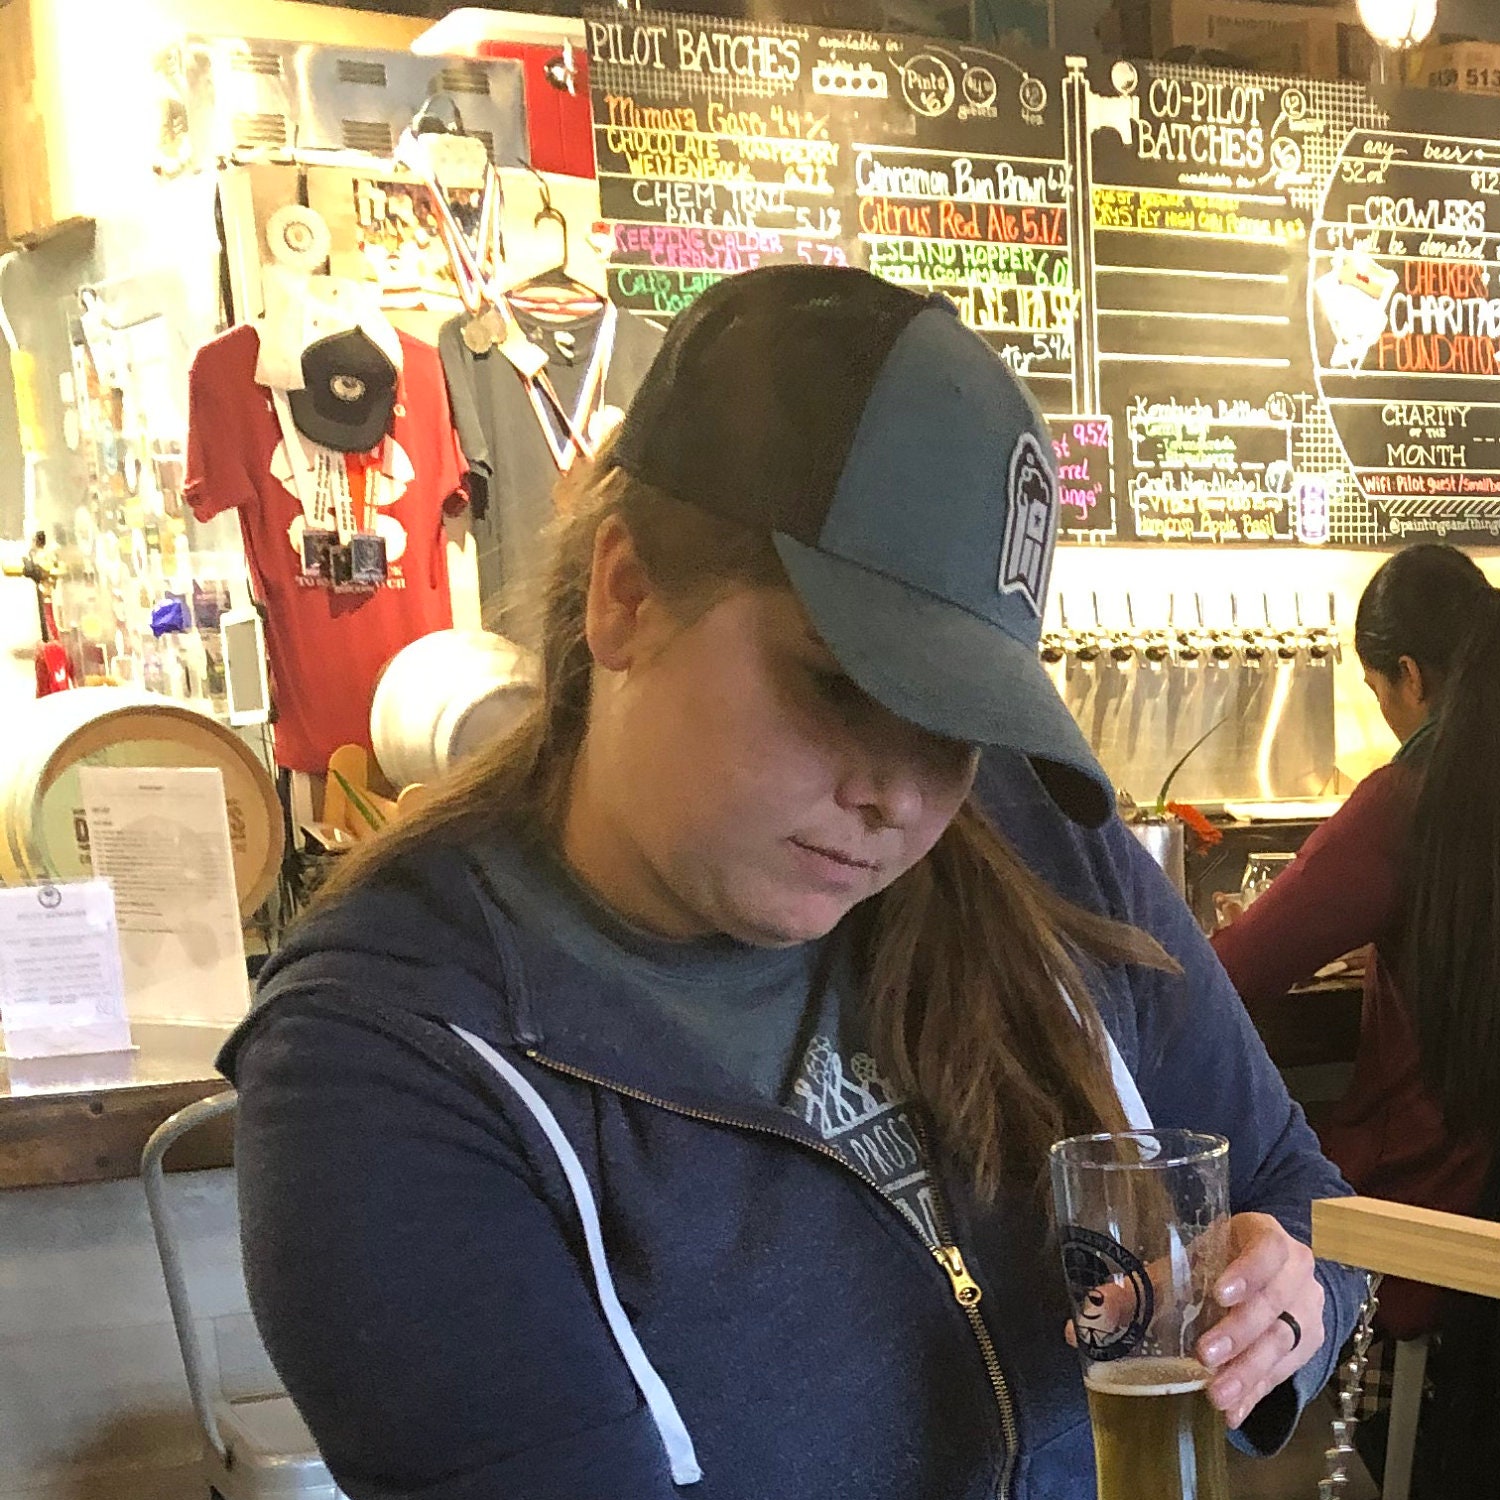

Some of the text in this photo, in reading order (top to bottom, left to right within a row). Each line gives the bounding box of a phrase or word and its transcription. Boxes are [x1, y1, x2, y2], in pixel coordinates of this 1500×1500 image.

[589, 22, 801, 81] PILOT BATCHES
[604, 94, 698, 133] Mimosa
[1149, 78, 1265, 127] CO-PILOT
[607, 129, 720, 160] CHOCOLATE
[1138, 119, 1265, 168] BATCHES
[1424, 140, 1473, 163] beer
[855, 151, 949, 197] Cinnamon
[951, 158, 995, 201] Bun
[996, 162, 1048, 204] Brown
[632, 181, 717, 210] CHEM
[665, 205, 713, 226] PALE
[722, 209, 757, 228] ALE
[859, 197, 1063, 244] Citrus Red Ale 5.1%
[1364, 195, 1487, 234] CROWLERS
[614, 223, 705, 253] KEEPING
[724, 252, 760, 270] ALE
[869, 241, 957, 266] ISLAND
[962, 244, 1037, 272] HOPPER
[1382, 404, 1470, 427] CHARITY
[1073, 422, 1108, 448] 9.5%
[1387, 443, 1466, 467] MONTH
